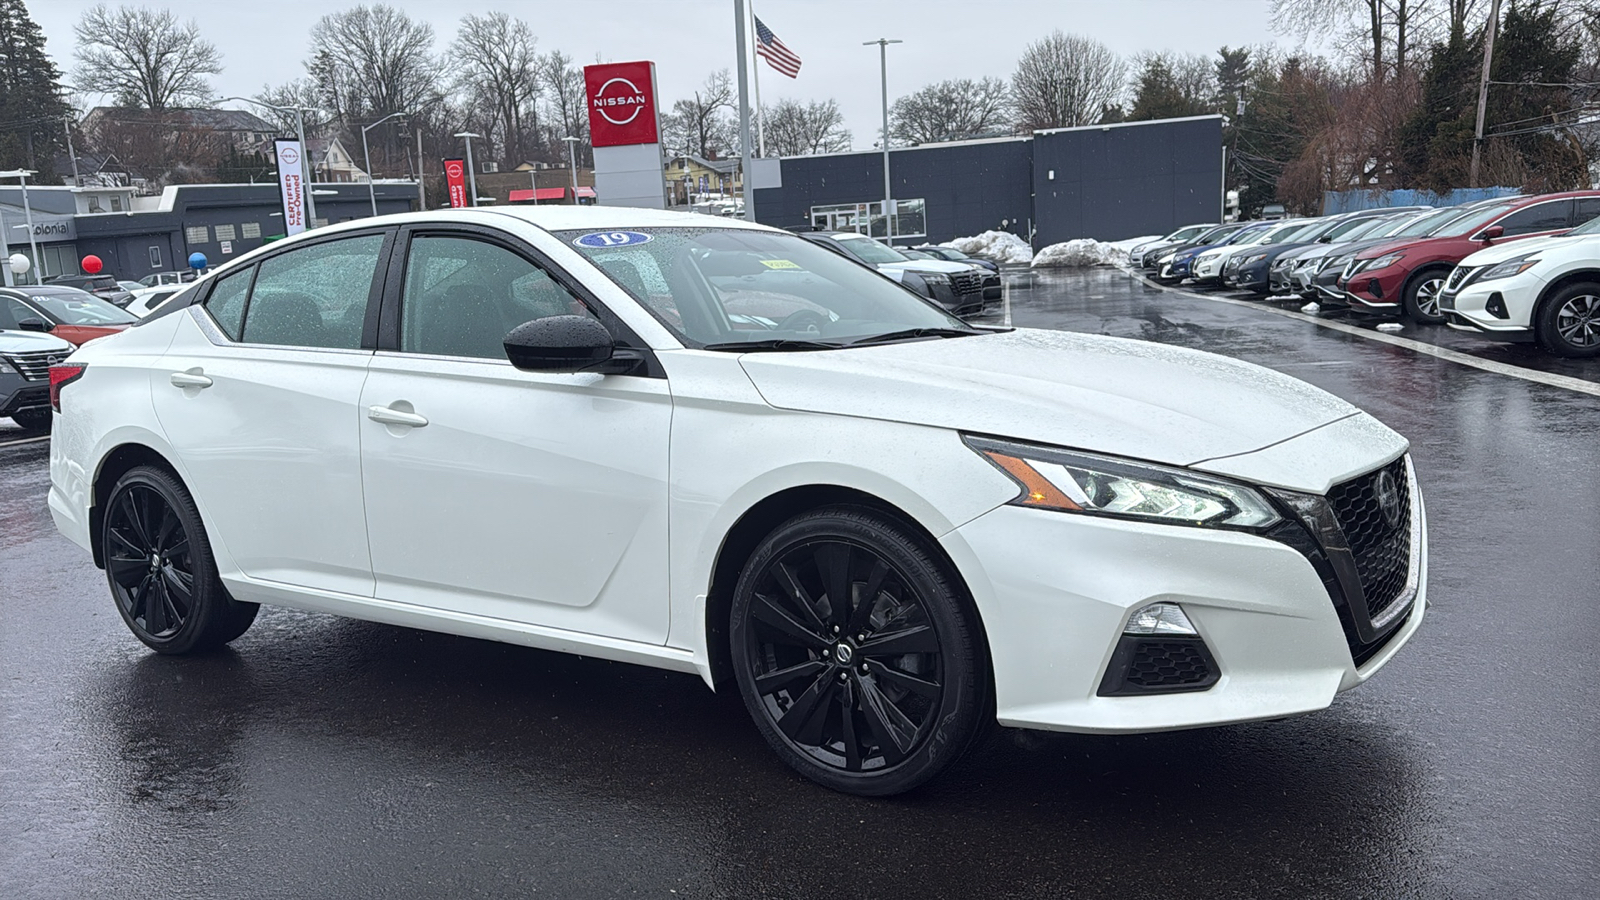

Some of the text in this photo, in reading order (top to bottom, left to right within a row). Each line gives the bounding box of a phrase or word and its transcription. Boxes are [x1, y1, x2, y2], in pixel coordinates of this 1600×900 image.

[593, 95, 646, 107] NISSAN
[285, 174, 295, 226] CERTIFIED
[291, 174, 302, 226] Pre-Owned
[451, 185, 459, 208] IFIED
[597, 232, 630, 246] 19
